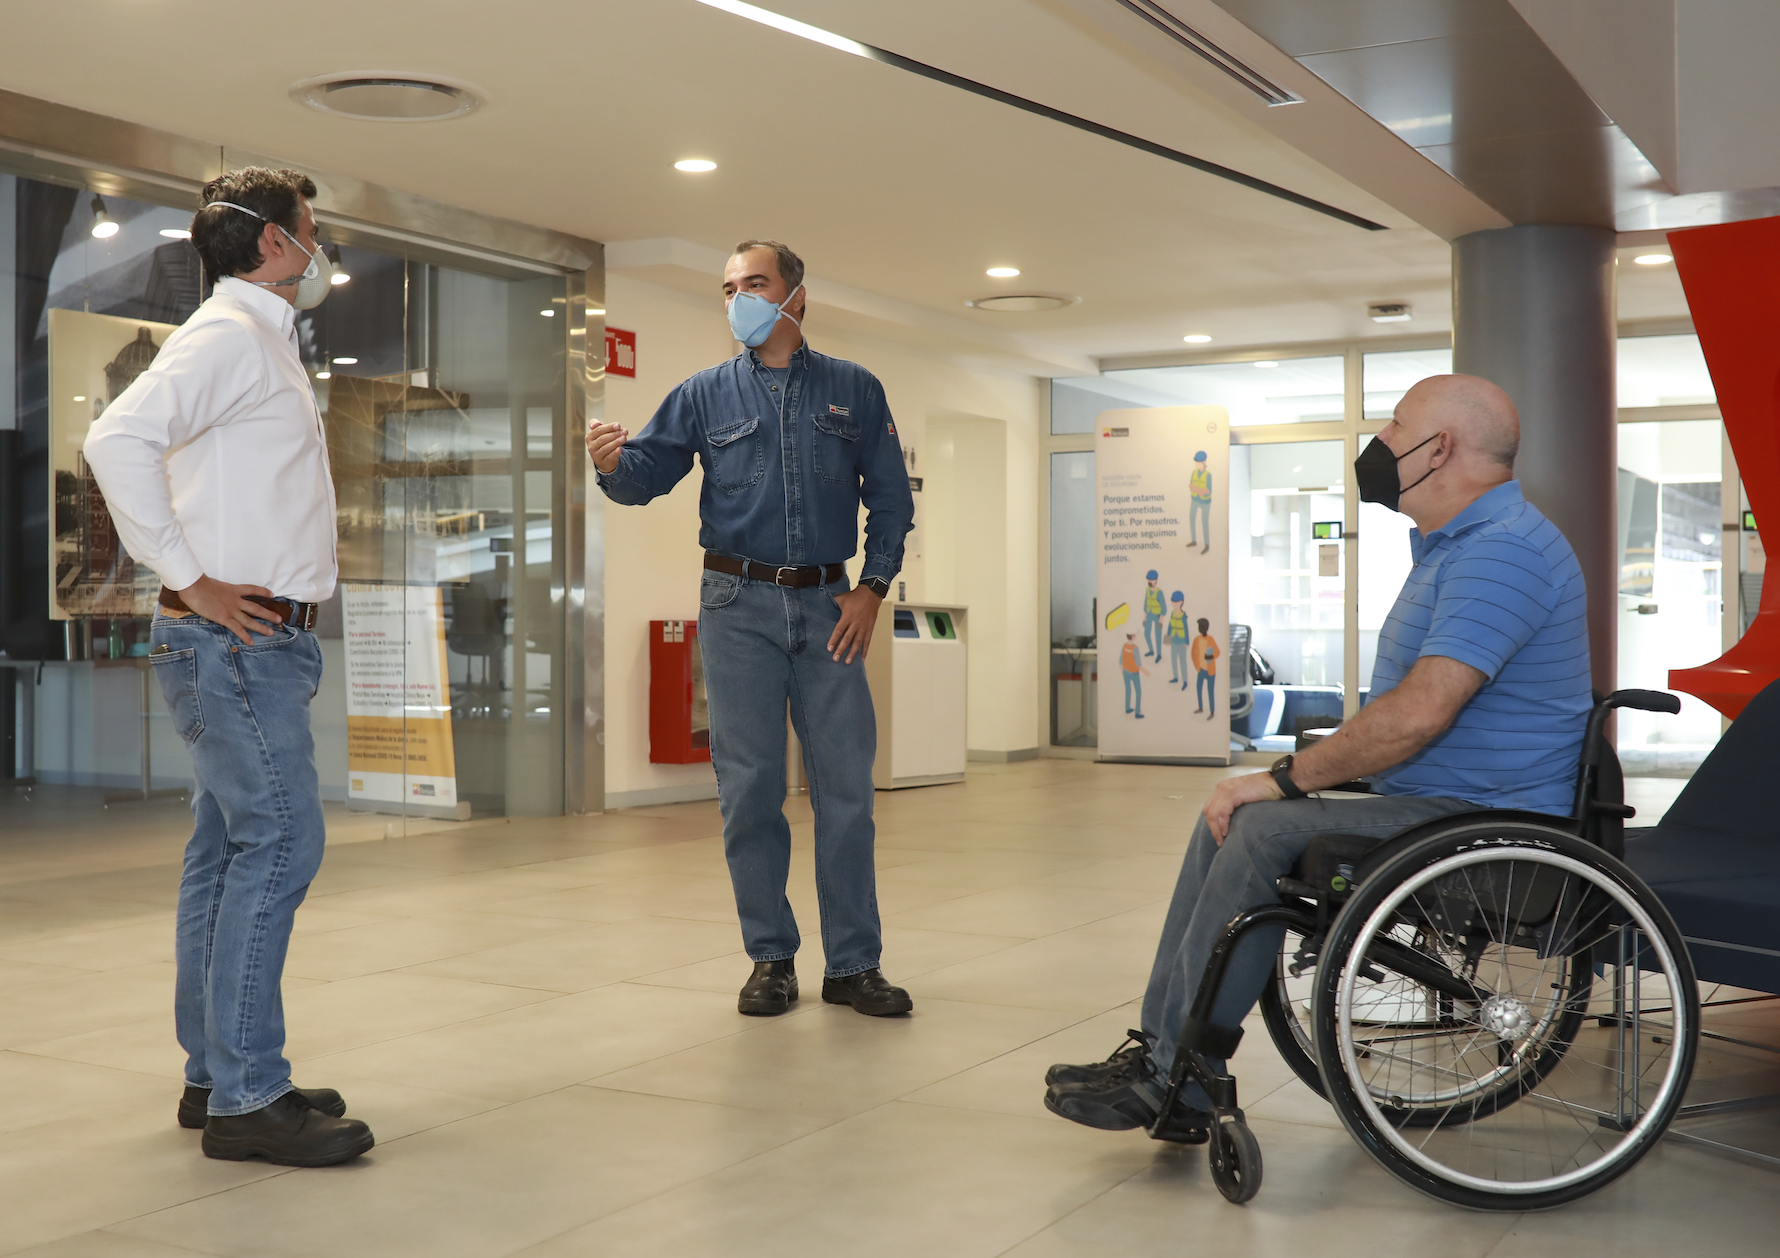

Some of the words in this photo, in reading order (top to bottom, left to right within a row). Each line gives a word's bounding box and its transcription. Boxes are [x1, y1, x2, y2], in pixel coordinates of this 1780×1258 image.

[1103, 495, 1130, 504] Porque
[1132, 494, 1165, 502] estamos
[1103, 505, 1165, 516] comprometidos.
[1103, 519, 1116, 527] Por
[1119, 518, 1127, 527] ti.
[1130, 518, 1143, 526] Por
[1145, 517, 1180, 525] nosotros.
[1111, 531, 1138, 540] porque
[1140, 529, 1177, 539] seguimos
[1104, 541, 1162, 551] evolucionando,
[1104, 555, 1130, 564] juntos.
